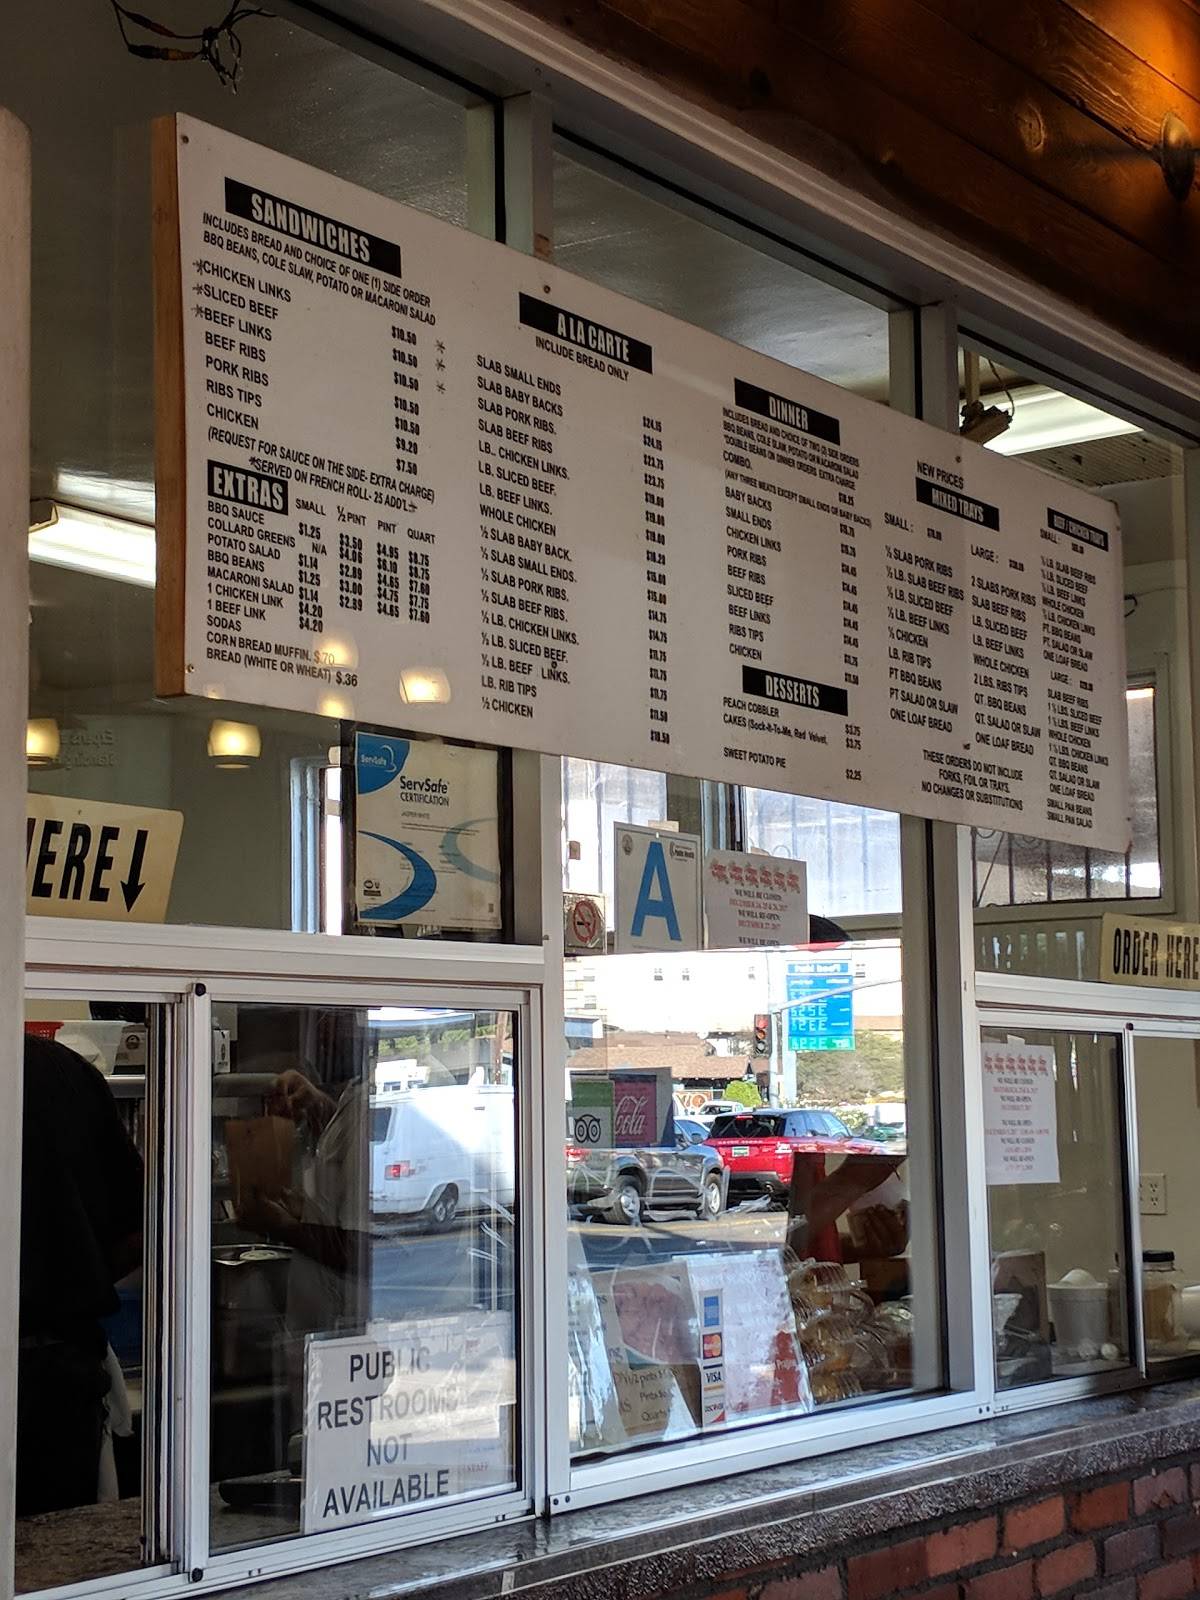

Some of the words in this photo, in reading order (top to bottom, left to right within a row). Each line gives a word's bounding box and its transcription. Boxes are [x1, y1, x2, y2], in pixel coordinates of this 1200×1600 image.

[252, 193, 370, 264] SANDWICHES
[203, 212, 248, 240] INCLUDES
[252, 231, 282, 252] BREAD
[284, 244, 302, 259] AND
[305, 251, 336, 273] CHOICE
[339, 265, 350, 277] OF
[353, 270, 369, 285] ONE
[372, 277, 381, 292] (1)
[383, 281, 401, 297] SIDE
[403, 288, 430, 308] ORDER
[204, 231, 224, 249] BBQ
[226, 239, 259, 263] BEANS,
[263, 253, 286, 272] COLE
[289, 262, 314, 284] SLAW,
[316, 273, 349, 294] POTATO
[351, 286, 363, 300] OR
[365, 291, 408, 316] MACARONI
[410, 307, 435, 326] SALAD
[203, 261, 255, 290] CHICKEN
[259, 280, 291, 302] LINKS
[392, 326, 416, 346] $10.50
[203, 284, 245, 309] SLICED
[249, 300, 278, 320] BEEF
[393, 348, 417, 368] $10.50
[558, 312, 566, 337] A
[570, 317, 585, 346] LA
[589, 325, 629, 363] CARTE
[204, 308, 235, 328] BEEF
[239, 319, 272, 341] LINKS
[394, 372, 419, 391] $10.50
[536, 336, 574, 361] INCLUDE
[577, 352, 605, 372] BREAD
[608, 364, 629, 381] ONLY
[206, 331, 235, 351] BEEF
[240, 343, 266, 363] RIBS
[395, 396, 419, 416] $10.50
[477, 355, 502, 374] SLAB
[505, 365, 535, 387] SMALL
[538, 377, 561, 396] ENDS
[206, 355, 239, 378] PORK
[242, 367, 268, 387] RIBS
[395, 417, 420, 436] $10.50
[478, 376, 502, 395] SLAB
[505, 386, 530, 404] BABY
[533, 396, 563, 417] BACKS
[770, 396, 808, 431] DINNER
[207, 379, 233, 398] RIBS
[237, 388, 262, 407] TIPS
[396, 437, 418, 455] $9.20
[207, 403, 258, 430] CHICKEN
[396, 458, 417, 476] $7.50
[479, 419, 503, 437] SLAB
[506, 428, 529, 445] BEEF
[532, 437, 552, 454] RIBS
[208, 426, 256, 450] (REQUEST
[258, 441, 277, 457] FOR
[280, 447, 310, 466] SAUCE
[313, 456, 325, 470] ON
[328, 460, 344, 476] THE
[370, 472, 397, 491] EXTRA
[399, 481, 435, 504] CHARGE)
[917, 461, 935, 479] NEW
[937, 468, 964, 490] PRICES
[214, 467, 283, 511] EXTRAS
[296, 499, 326, 516] SMALL
[347, 512, 366, 526] PINT
[378, 520, 396, 534] PINT
[407, 528, 435, 544] QUART
[726, 487, 745, 502] BABY
[747, 494, 772, 512] BACKS
[959, 499, 984, 523] TRAYS
[208, 501, 229, 516] BBQ
[232, 507, 264, 525] SAUCE
[299, 522, 321, 540] $1.25
[209, 518, 254, 537] COLLARD
[258, 529, 295, 548] GREENS
[312, 542, 327, 556] N/A
[480, 504, 514, 524] WHOLE
[517, 515, 556, 537] CHICKEN
[726, 506, 751, 524] SMALL
[753, 515, 771, 531] ENDS
[208, 533, 246, 552] POTATO
[249, 543, 280, 560] SALAD
[299, 553, 318, 570] $1.14
[208, 550, 229, 565] BBQ
[232, 555, 264, 572] BEANS
[299, 570, 320, 587] $1.25
[208, 566, 260, 587] MACARONI
[263, 578, 294, 594] SALAD
[299, 586, 318, 603] $1.14
[208, 583, 211, 593] 1
[216, 584, 259, 603] CHICKEN
[262, 594, 283, 608] LINK
[299, 600, 323, 618] $4.20
[207, 615, 241, 632] SODAS
[208, 599, 212, 610] 1
[216, 600, 241, 615] BEEF
[244, 606, 266, 621] LINK
[299, 616, 323, 633] $4.20
[207, 648, 241, 664] BREAD
[244, 655, 277, 671] (WHITE
[280, 661, 294, 674] OR
[296, 664, 331, 684] WHEAT)
[336, 671, 358, 687] $.36
[730, 643, 762, 661] CHICKEN
[973, 654, 999, 670] WHOLE
[1000, 661, 1029, 679] CHICKEN
[723, 697, 746, 710] PEACH
[748, 703, 779, 718] COBBLER
[766, 675, 820, 707] DESSERTS
[890, 708, 906, 722] ONE
[908, 712, 926, 726] LOAF
[929, 717, 952, 733] BREAD
[724, 747, 747, 761] SWEET
[749, 752, 774, 766] POTATO
[776, 757, 786, 768] PIE
[923, 750, 944, 764] THESE
[946, 755, 972, 770] ORDERS
[973, 761, 982, 772] DO
[984, 763, 996, 775] NOT
[998, 766, 1023, 781] INCLUDE
[400, 776, 447, 794] ServSafe
[922, 781, 932, 793] NO
[933, 783, 964, 799] CHANGES
[966, 790, 975, 801] OR
[976, 792, 1023, 811] SUBSTITUTIONS
[964, 774, 977, 786] FOIL
[979, 777, 988, 788] OR
[400, 793, 449, 807] CERTIFICATION
[631, 841, 682, 941] A
[1113, 927, 1159, 977] ORDER
[1166, 934, 1200, 980] HERE
[350, 1347, 430, 1382] PUBLIC
[706, 1372, 721, 1383] VISA
[317, 1384, 457, 1430] RESTROOMS
[367, 1433, 412, 1467] NOT
[322, 1469, 450, 1518] AVAILABLE
